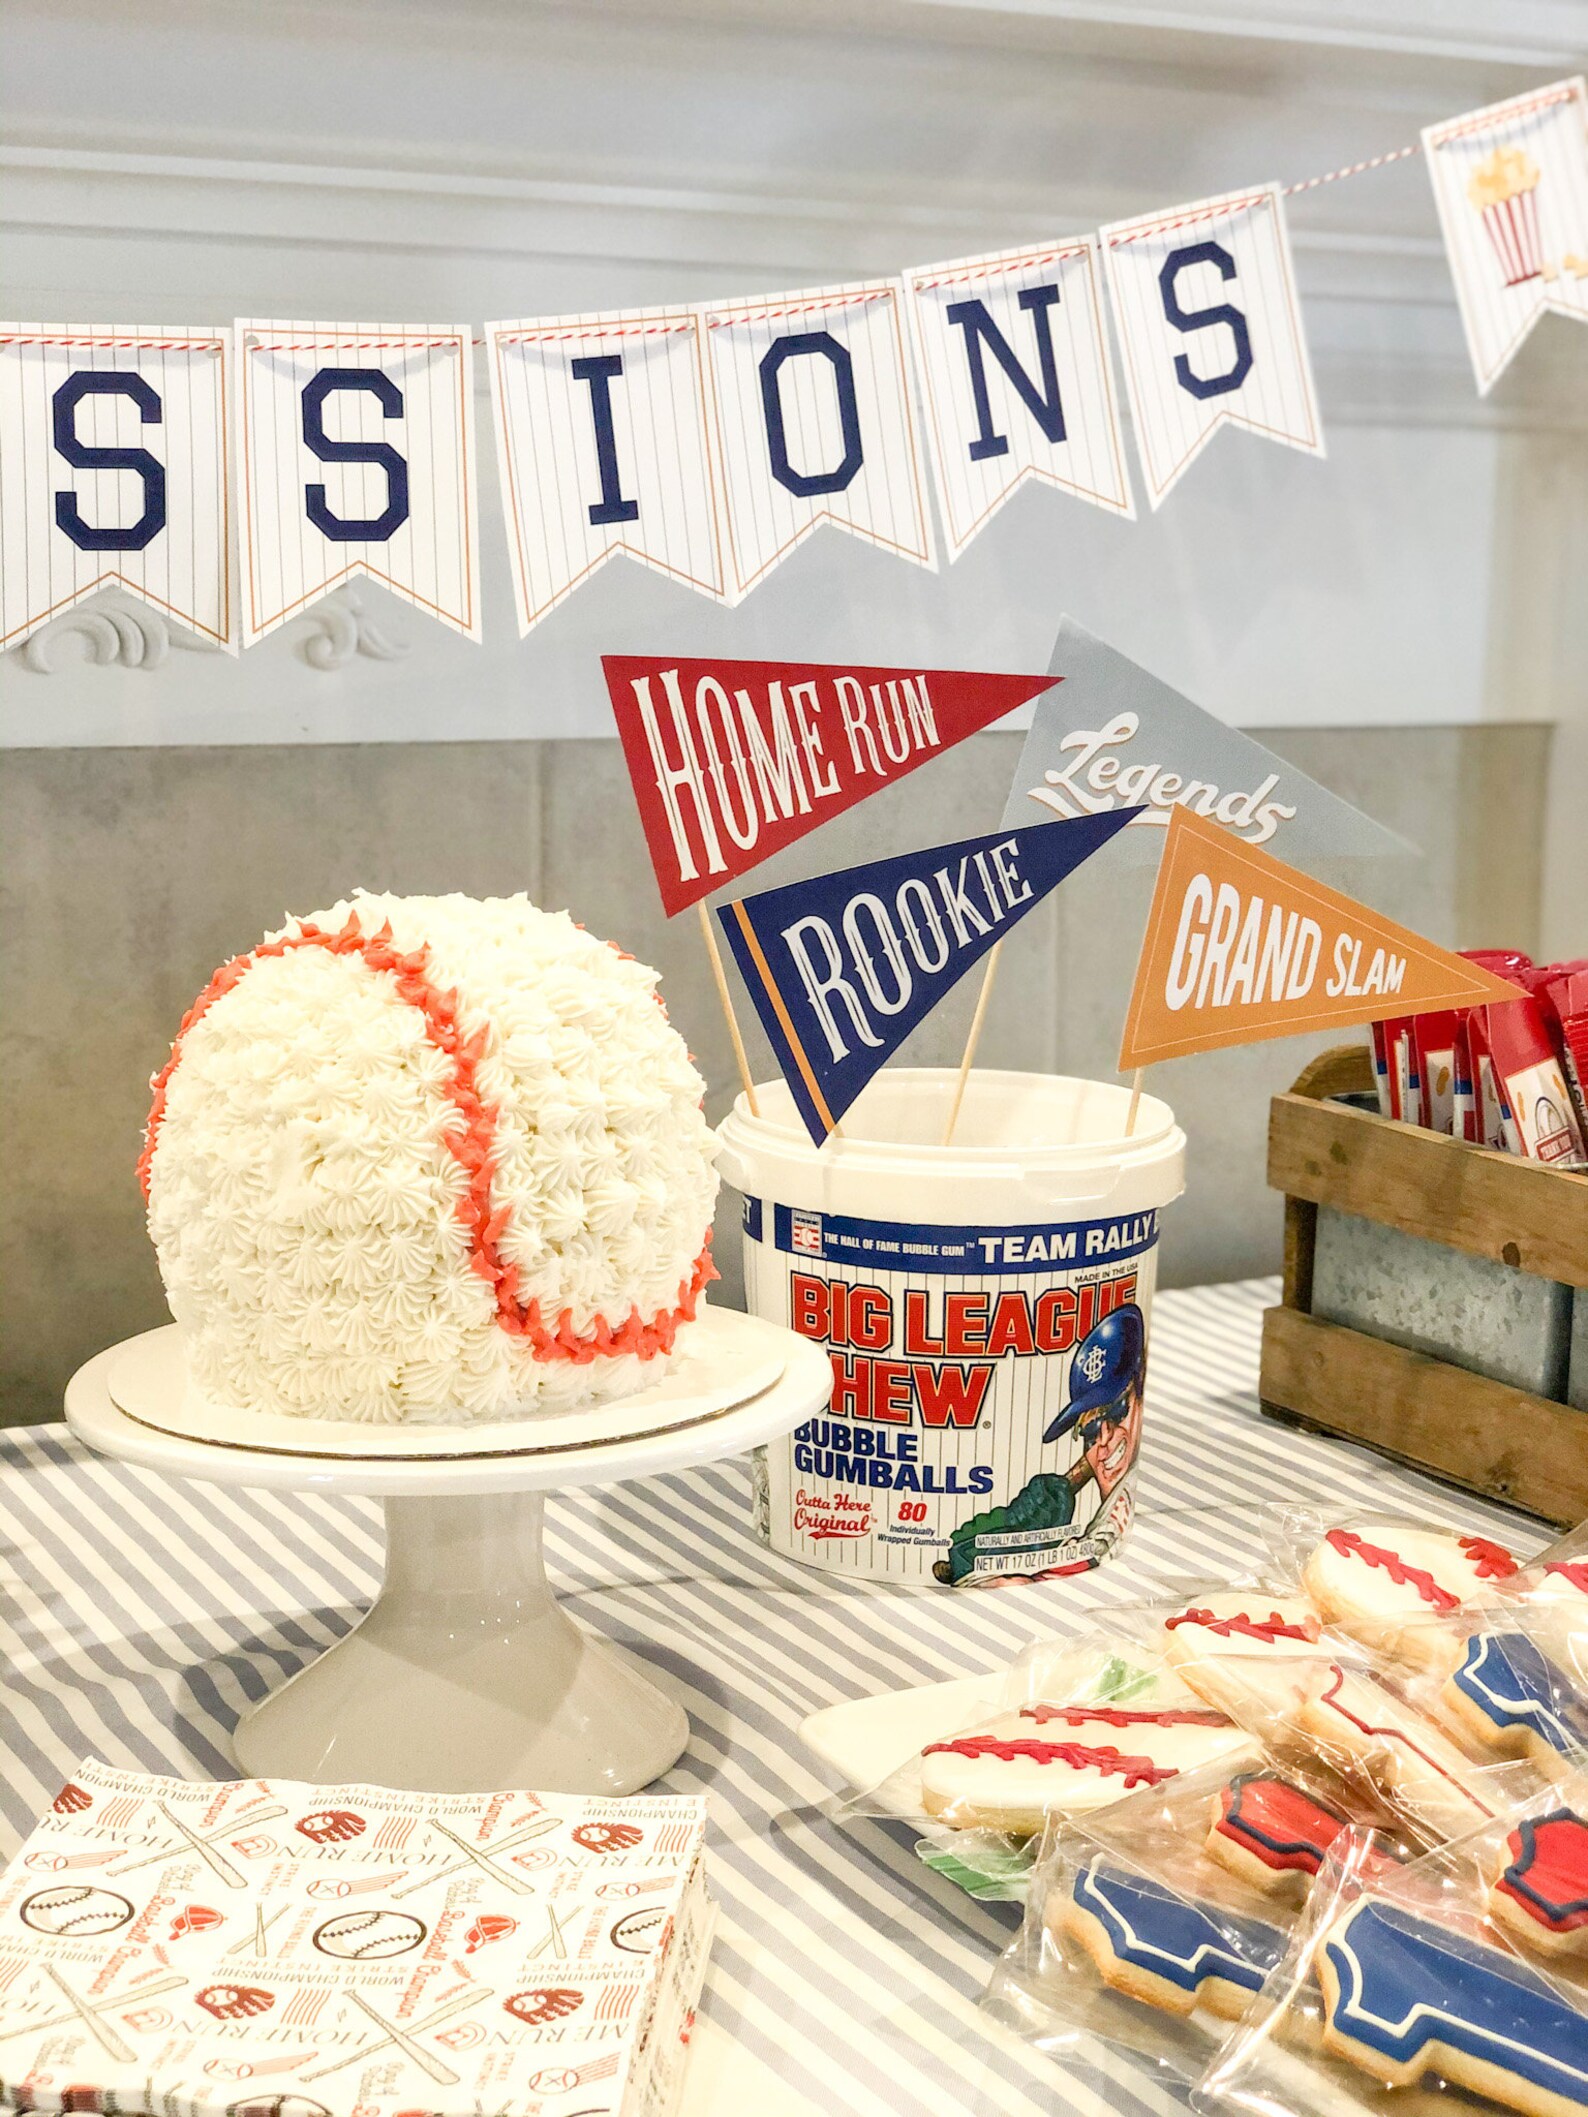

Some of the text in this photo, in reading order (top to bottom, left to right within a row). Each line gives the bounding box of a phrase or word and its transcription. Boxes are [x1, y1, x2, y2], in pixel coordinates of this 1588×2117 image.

[630, 669, 941, 882] HOME RUN
[1045, 711, 1296, 844] Legends
[781, 838, 1034, 1063] ROOKIE
[1165, 873, 1406, 1011] GRAND SLAM
[824, 1232, 838, 1245] THE
[840, 1233, 860, 1248] HALL
[862, 1237, 874, 1250] OF
[876, 1239, 899, 1253] FAME
[902, 1242, 939, 1256] BUBBLE
[978, 1232, 1077, 1264] TEAM
[1085, 1212, 1153, 1256] RALLY
[1075, 1263, 1138, 1283] MADE IN THE USA
[790, 1270, 894, 1354] BIG
[827, 1350, 995, 1430] HEW
[794, 1418, 918, 1462] BUBBLE
[794, 1443, 994, 1494] GUMBALLS
[796, 1489, 871, 1512] Outta Here
[898, 1501, 928, 1523] 80
[794, 1507, 872, 1536] Original
[889, 1524, 935, 1537] Individually
[877, 1534, 951, 1548] Wrapped Gumballs
[977, 1535, 1009, 1547] NATURALLY
[1011, 1534, 1023, 1544] AND
[977, 1557, 993, 1571] NET
[996, 1556, 1010, 1570] WT
[1012, 1555, 1022, 1569] 17
[1025, 1553, 1036, 1568] OZ
[1047, 1550, 1058, 1564] LB
[276, 1845, 348, 1861] RUN
